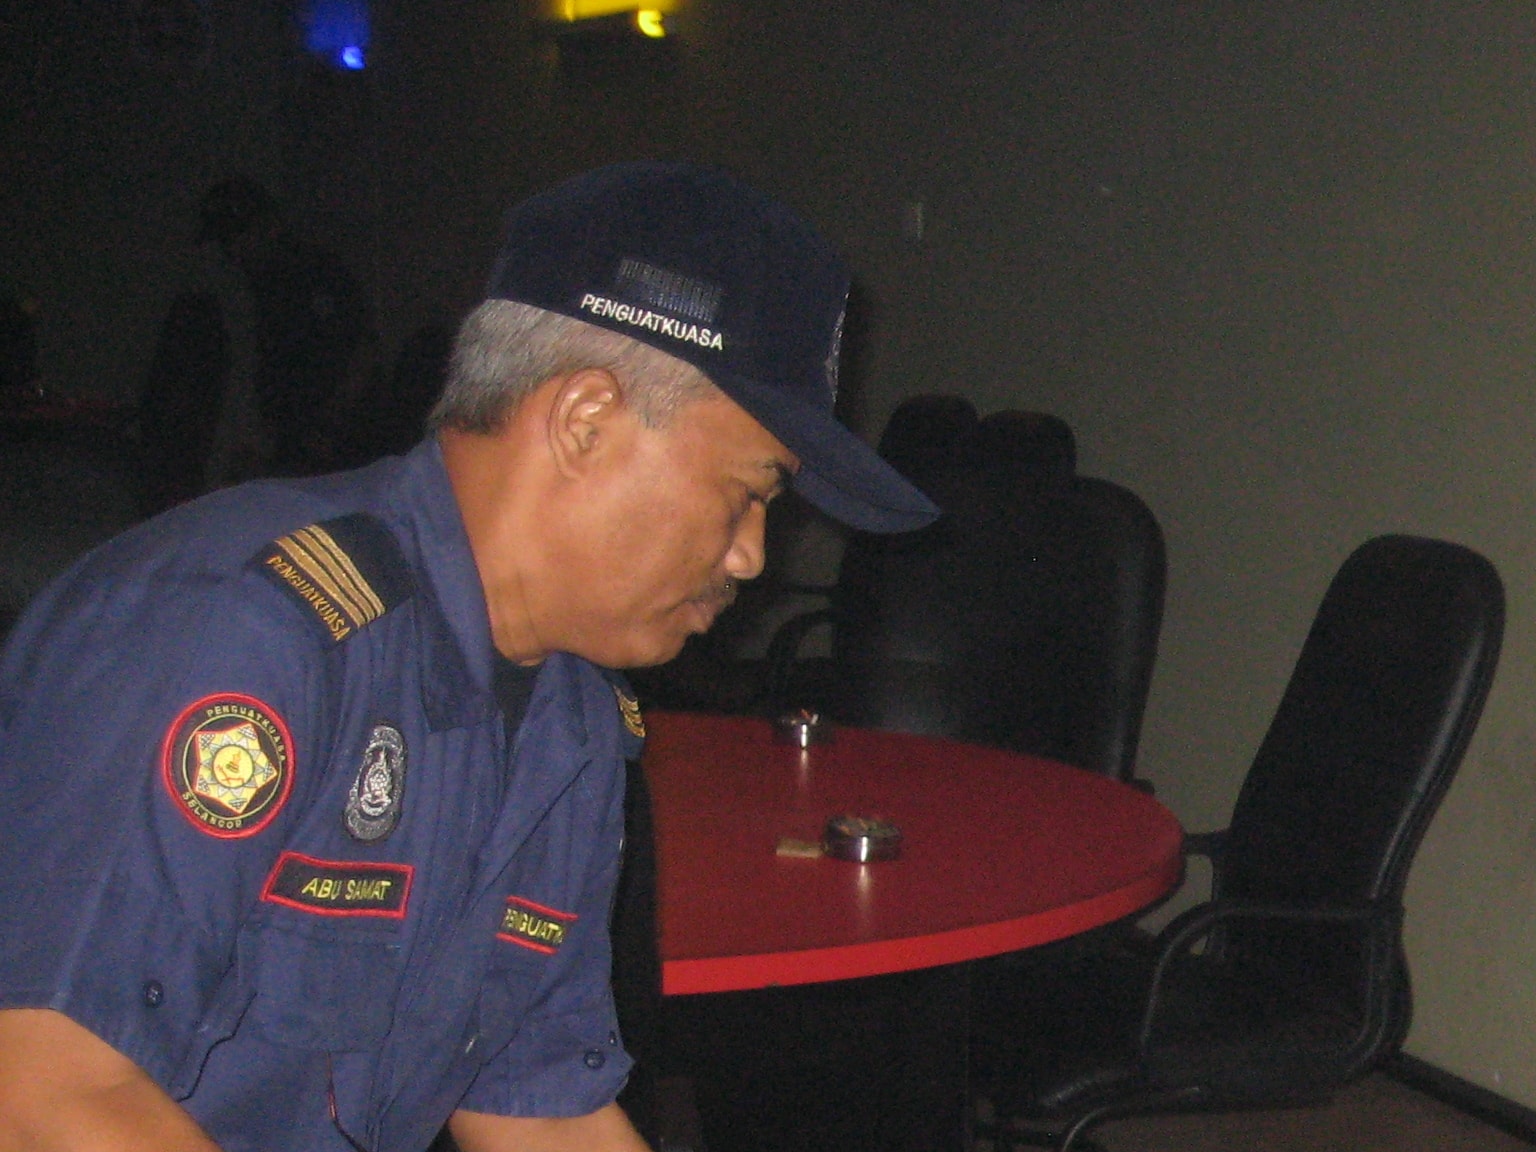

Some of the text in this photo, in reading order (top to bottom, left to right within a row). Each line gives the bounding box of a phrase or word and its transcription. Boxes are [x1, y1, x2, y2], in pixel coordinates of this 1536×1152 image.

[580, 293, 723, 350] PENGUATKUASA
[265, 555, 351, 641] PENGUATKUASA
[206, 705, 287, 761] PENGUATKUASA
[182, 791, 243, 829] SELANGOR
[301, 877, 392, 900] ABU SAMAT
